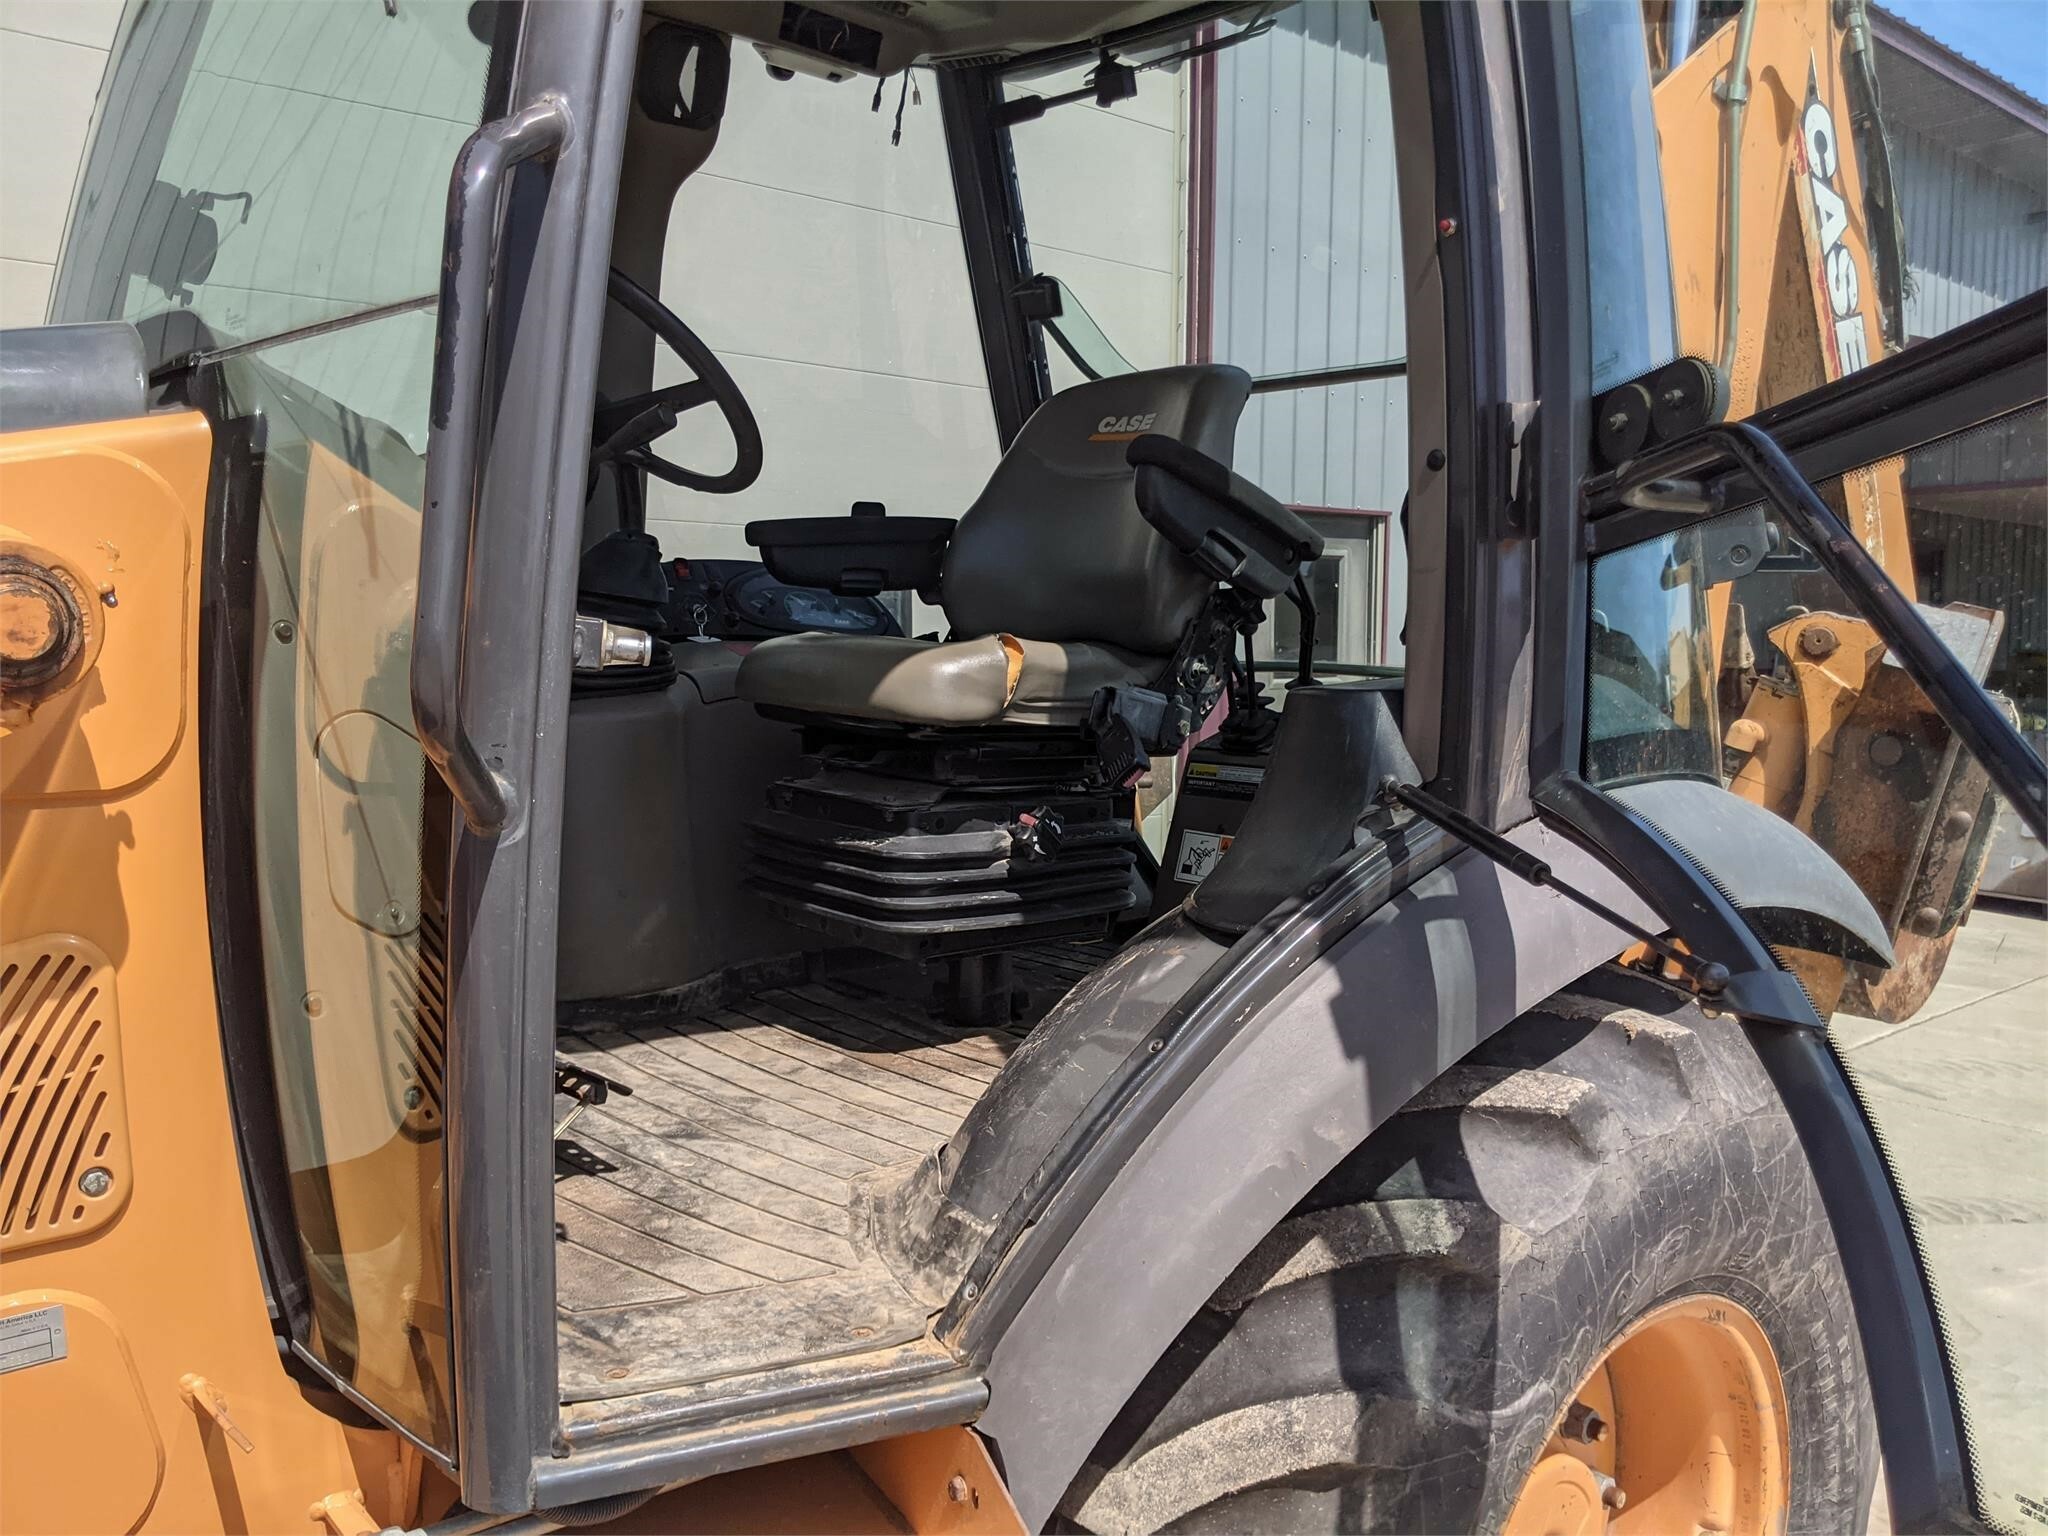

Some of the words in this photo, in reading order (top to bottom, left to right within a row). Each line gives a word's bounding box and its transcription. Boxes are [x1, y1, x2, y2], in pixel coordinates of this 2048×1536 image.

[1803, 102, 1870, 377] CASE
[1098, 413, 1157, 433] CASE
[6, 1314, 33, 1324] America
